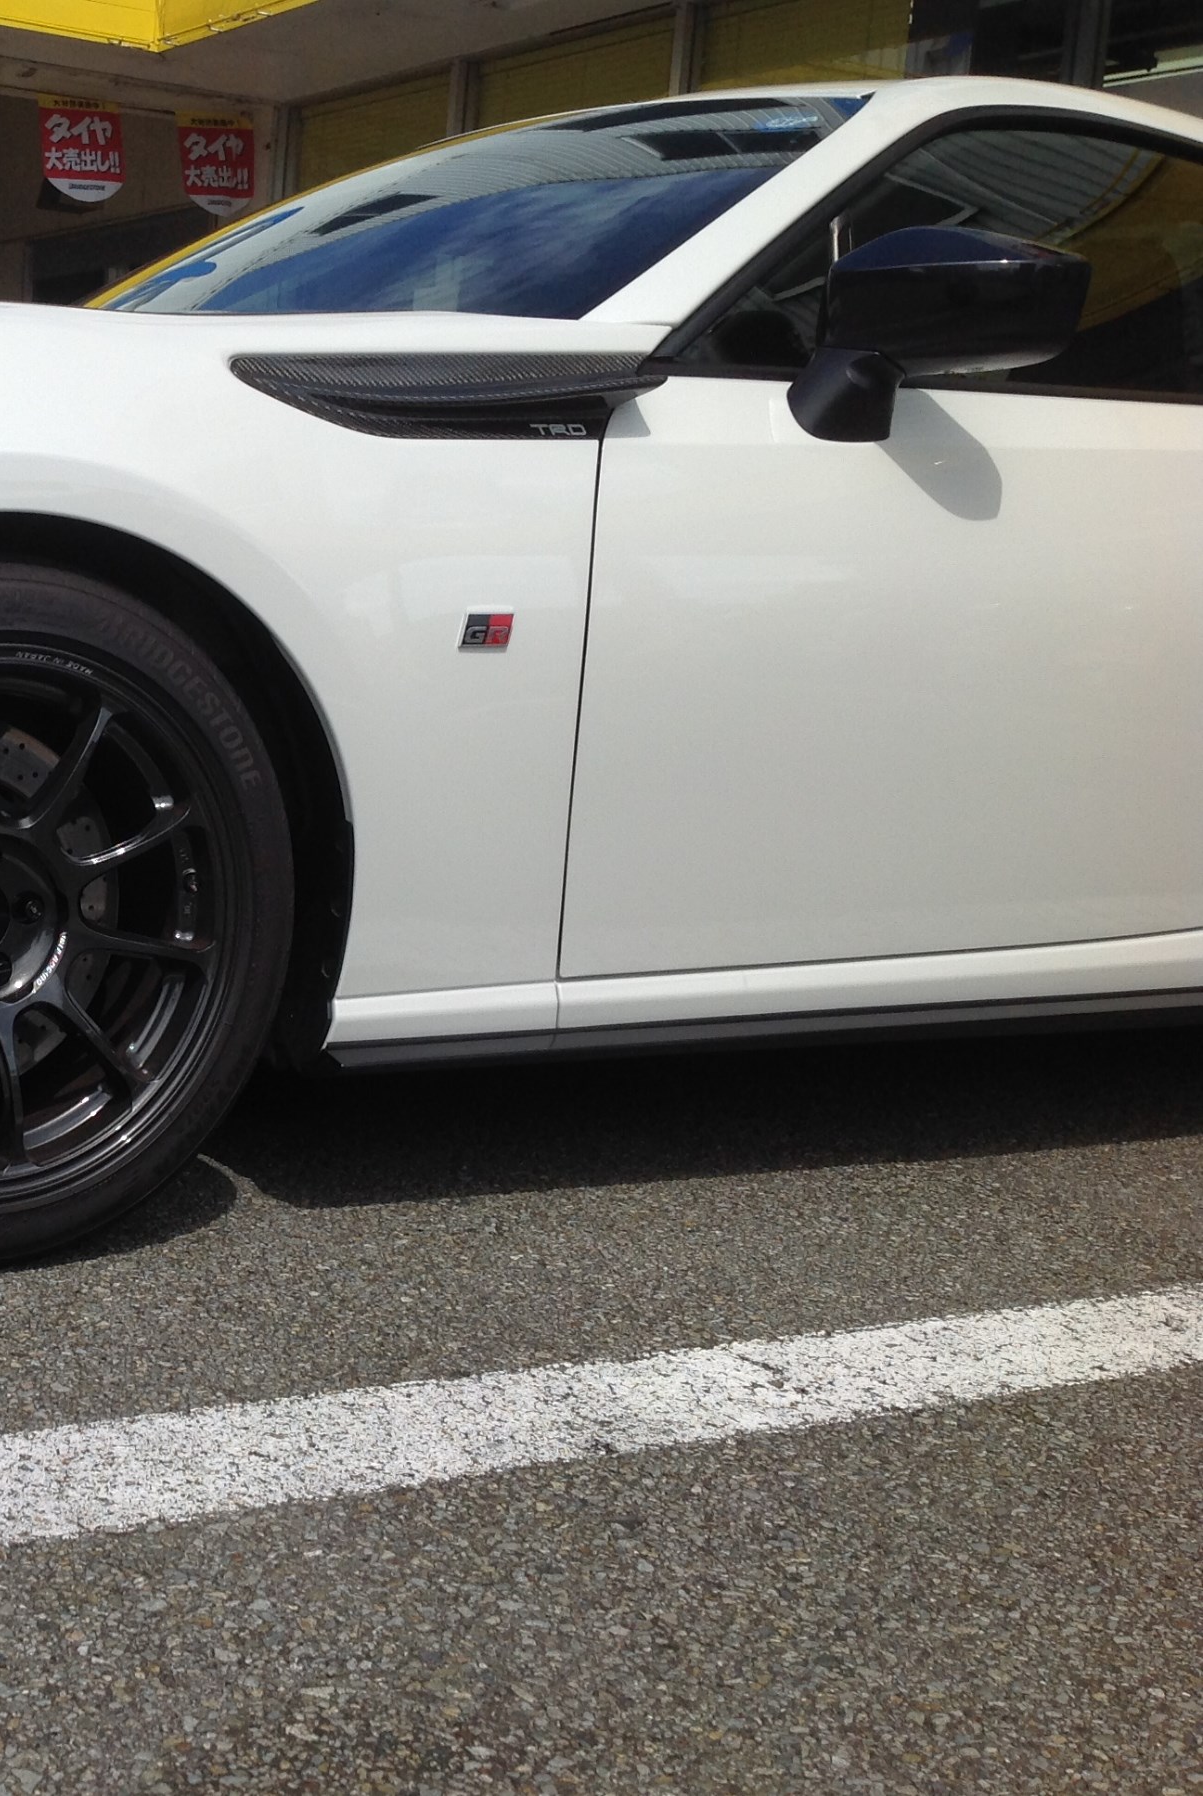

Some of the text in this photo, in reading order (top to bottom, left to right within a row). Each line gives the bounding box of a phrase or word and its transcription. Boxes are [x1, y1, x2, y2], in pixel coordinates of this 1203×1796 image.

[44, 114, 113, 145] タイヤ
[44, 146, 121, 174] 大売出し!!
[183, 132, 244, 161] タイヤ
[529, 423, 587, 436] TRD
[463, 625, 510, 644] GR
